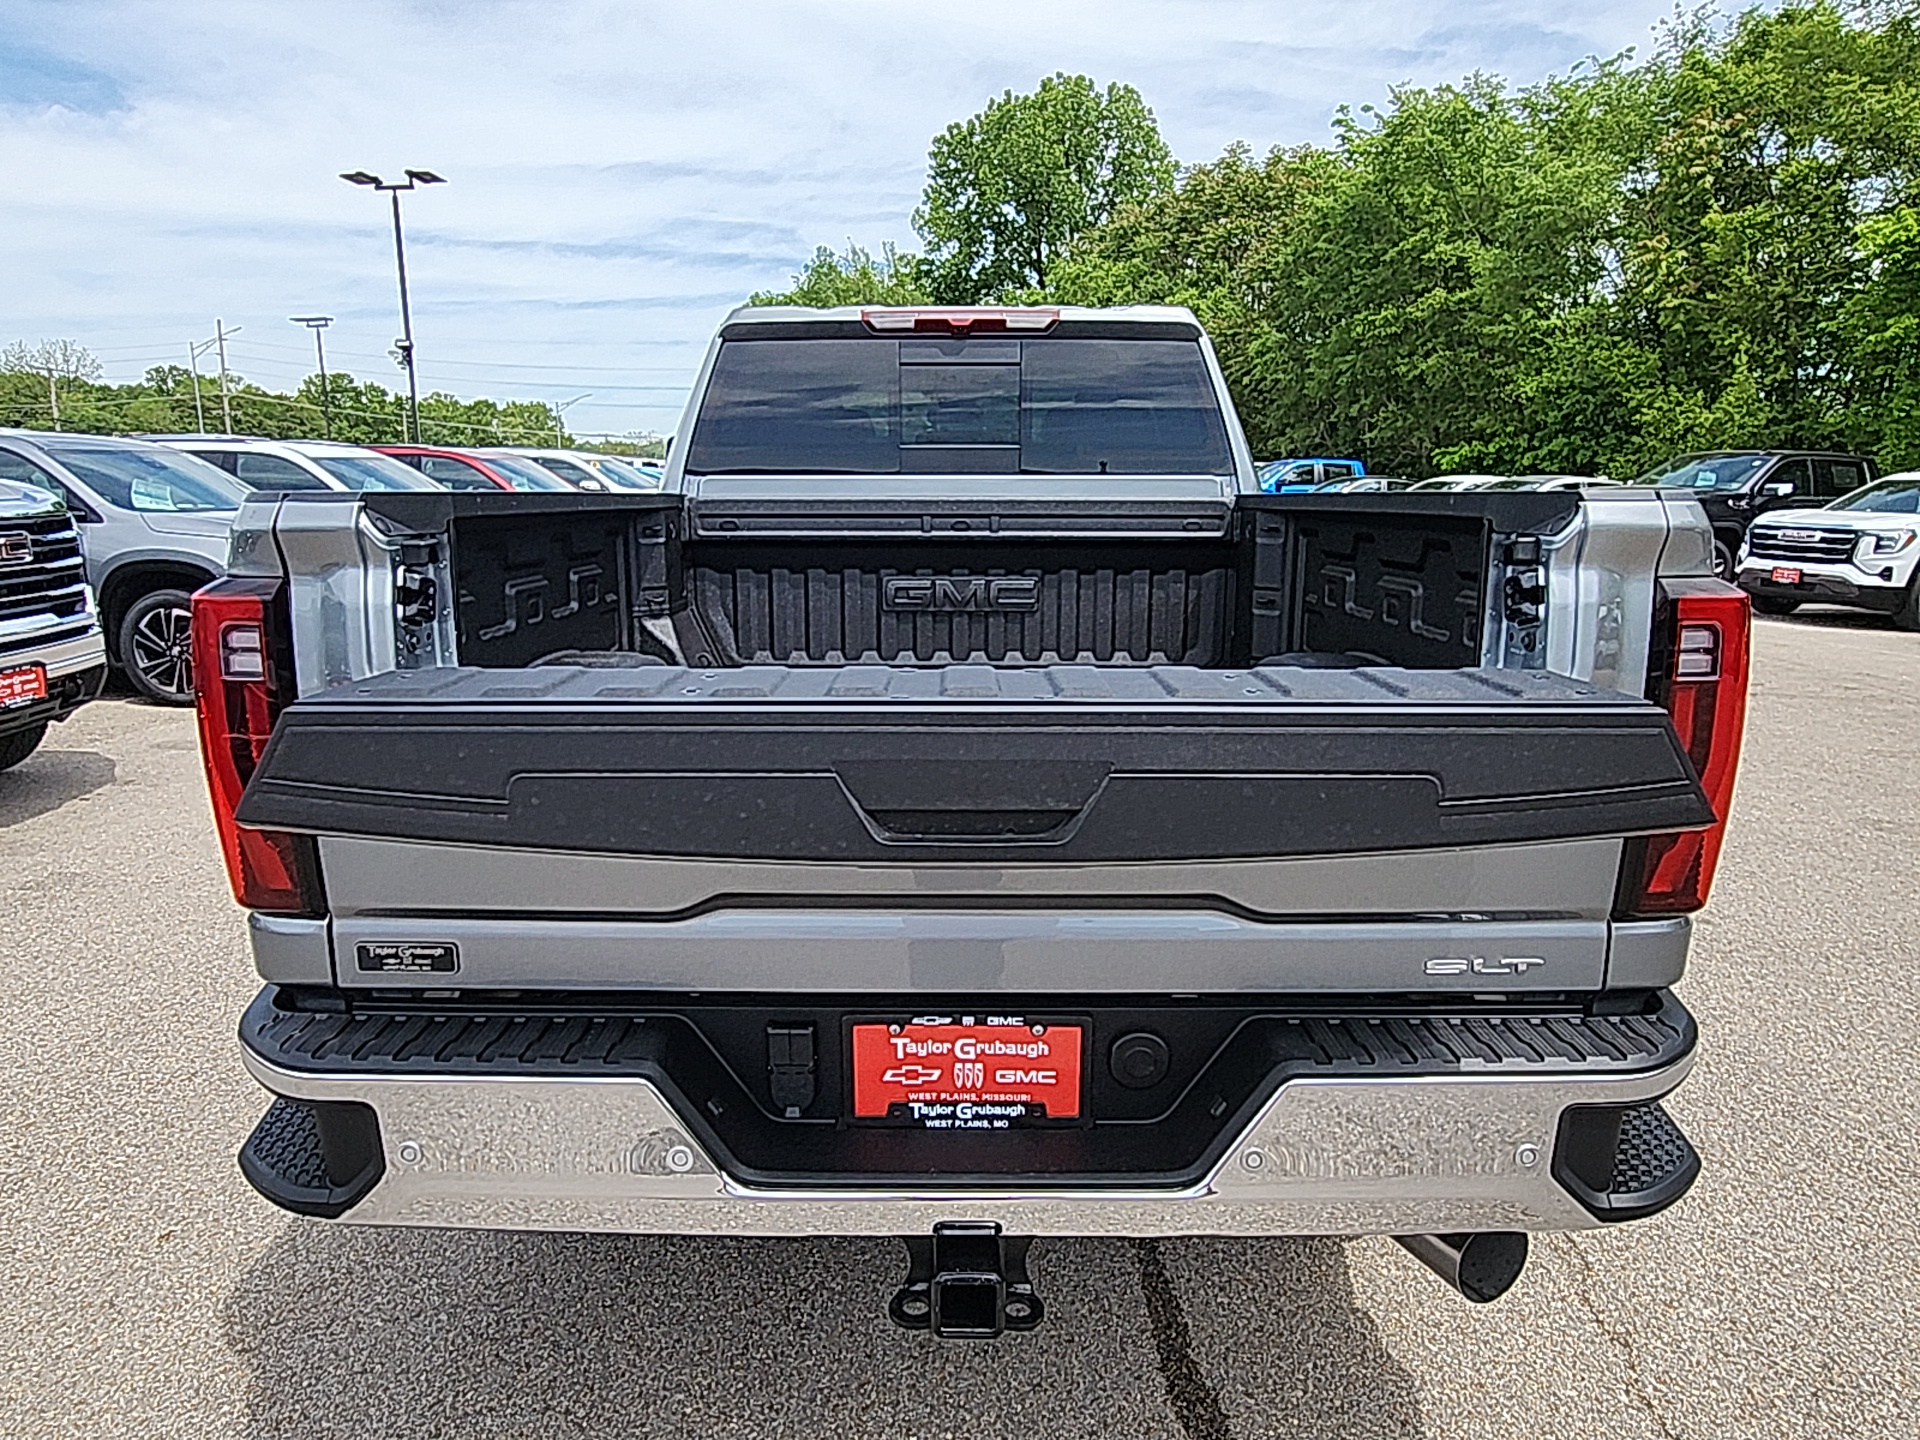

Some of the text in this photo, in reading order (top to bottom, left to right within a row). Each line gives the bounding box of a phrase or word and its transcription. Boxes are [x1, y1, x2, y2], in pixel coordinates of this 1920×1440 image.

[886, 580, 1036, 610] GMC
[1424, 957, 1546, 975] SLT
[987, 1016, 1024, 1025] GMC
[890, 1038, 1049, 1059] Taylor Grubaugh
[995, 1070, 1057, 1084] GMC
[908, 1092, 1031, 1102] WEST PLAINS, MISSOURI
[908, 1103, 1025, 1119] Taylor Grubaugh
[925, 1120, 953, 1128] WEST
[993, 1120, 1009, 1128] MO
